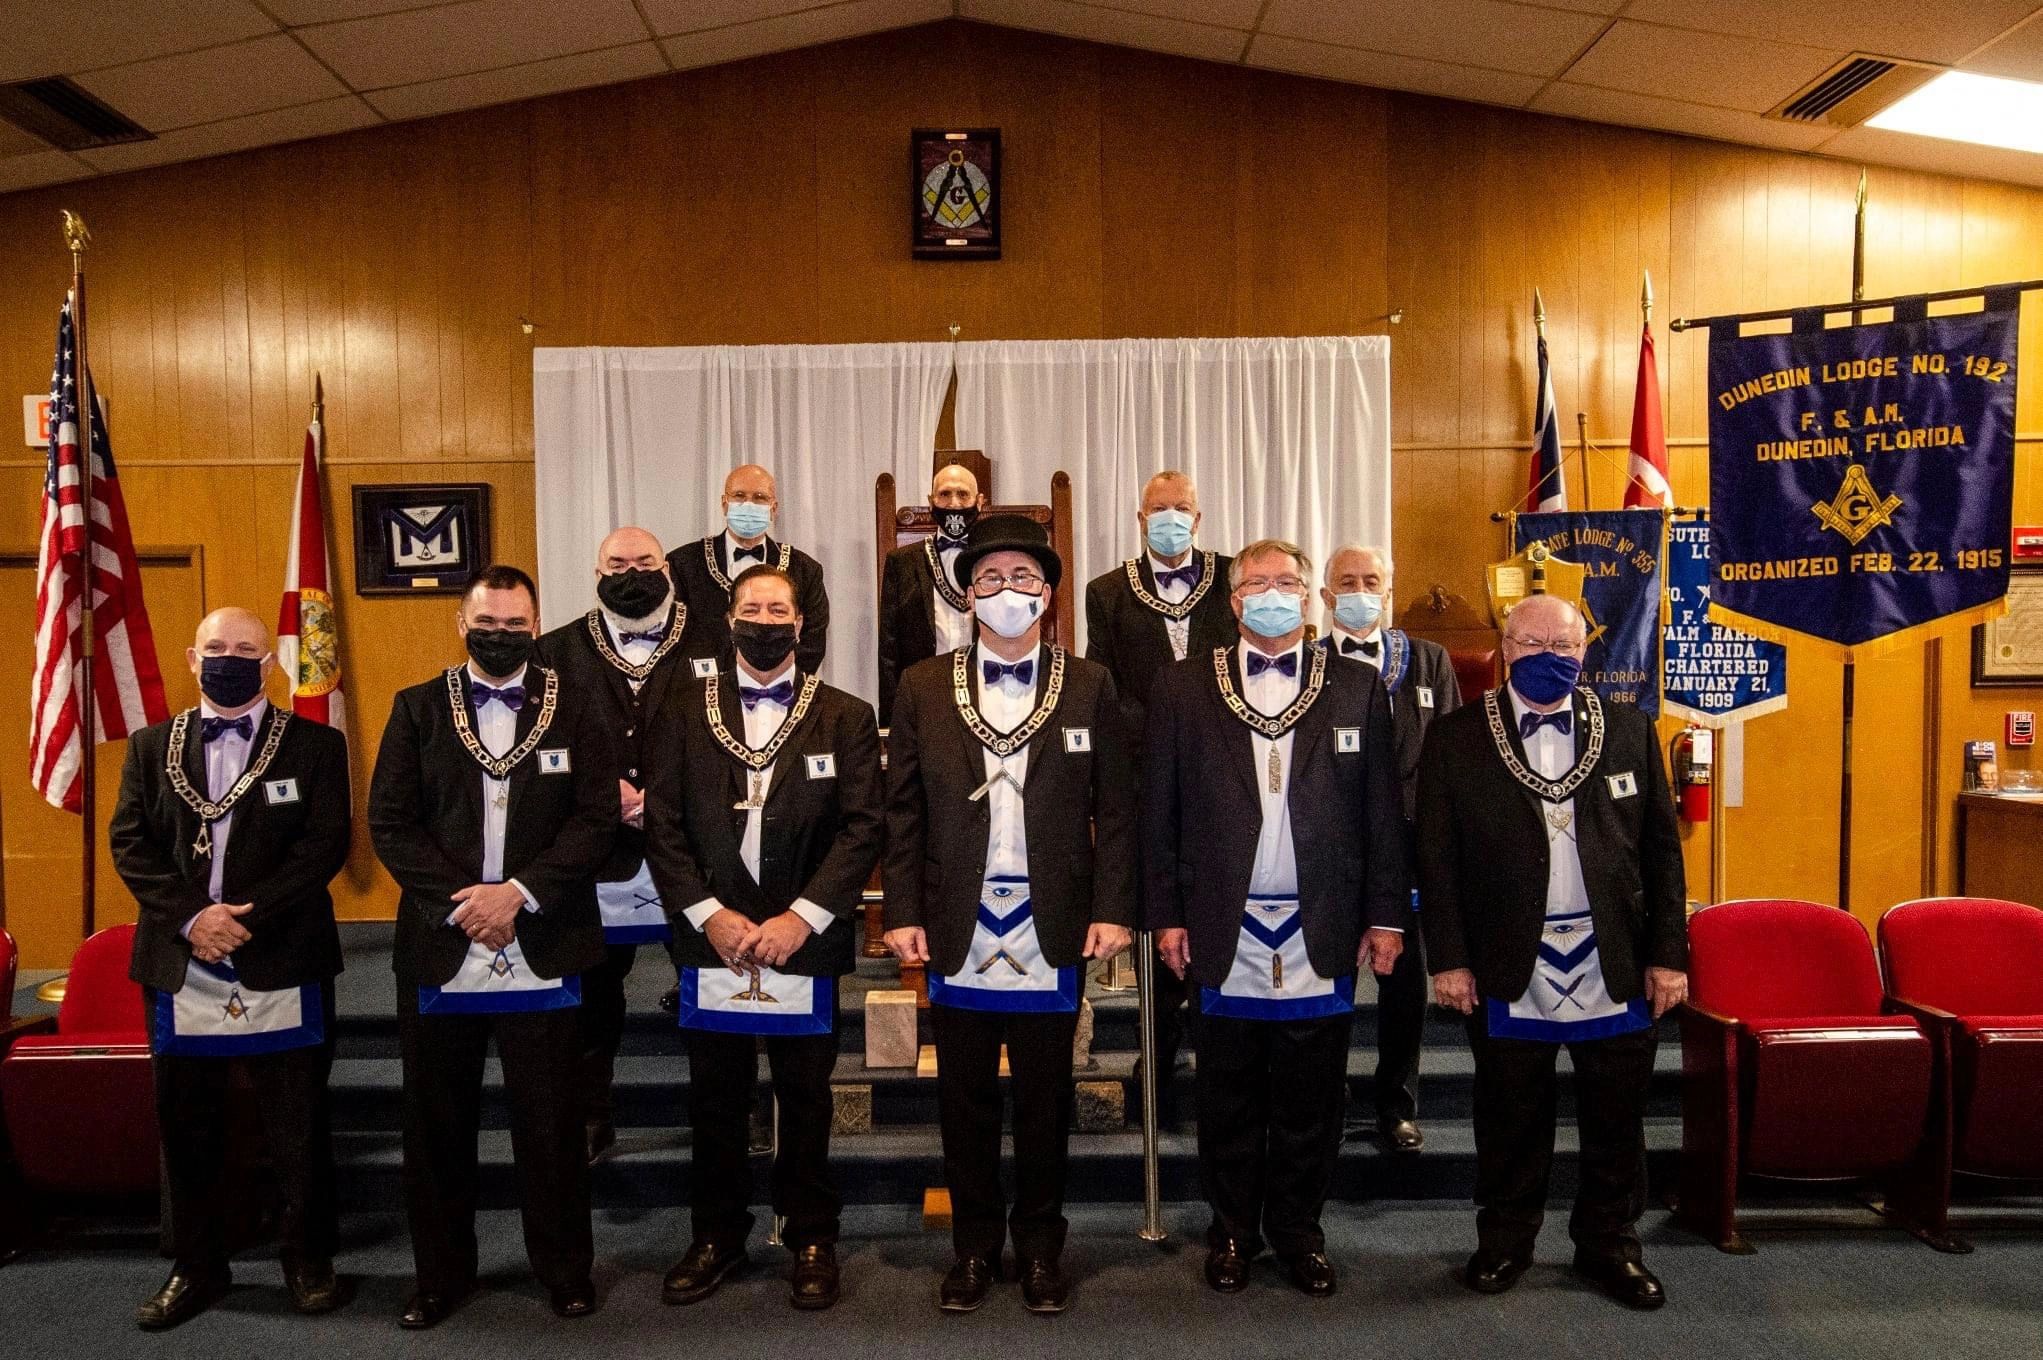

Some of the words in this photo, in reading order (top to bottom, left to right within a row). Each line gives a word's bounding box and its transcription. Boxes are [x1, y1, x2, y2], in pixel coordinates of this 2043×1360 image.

[949, 186, 970, 205] G
[1719, 366, 1811, 411] DUNEDIN
[1822, 357, 1898, 383] LODGE
[1911, 354, 1950, 374] NO.
[1964, 355, 2008, 382] 192
[1801, 411, 1822, 432] F.
[1833, 409, 1851, 429] &
[1863, 403, 1904, 426] A.M.
[1756, 436, 1853, 462] DUNEDIN,
[1866, 425, 1965, 453] FLORIDA
[1840, 495, 1871, 520] G
[1669, 527, 1710, 543] SUTH
[1546, 531, 1570, 553] ATE
[1574, 527, 1616, 549] LODGE
[1631, 549, 1657, 574] 355
[1721, 557, 1839, 581] ORGANIZED
[1850, 553, 1897, 573] FEB.
[1908, 552, 1944, 572] 22,
[1957, 549, 2002, 569] 1915
[1682, 609, 1698, 625] F.
[1678, 642, 1756, 658] FLORIDA
[1664, 659, 1769, 675] CHARTERED
[1595, 671, 1647, 684] FLORIDA
[1663, 676, 1739, 691] JANUARY
[1751, 676, 1771, 693] 21,
[1610, 690, 1637, 704] 1966
[1698, 692, 1734, 708] 1909
